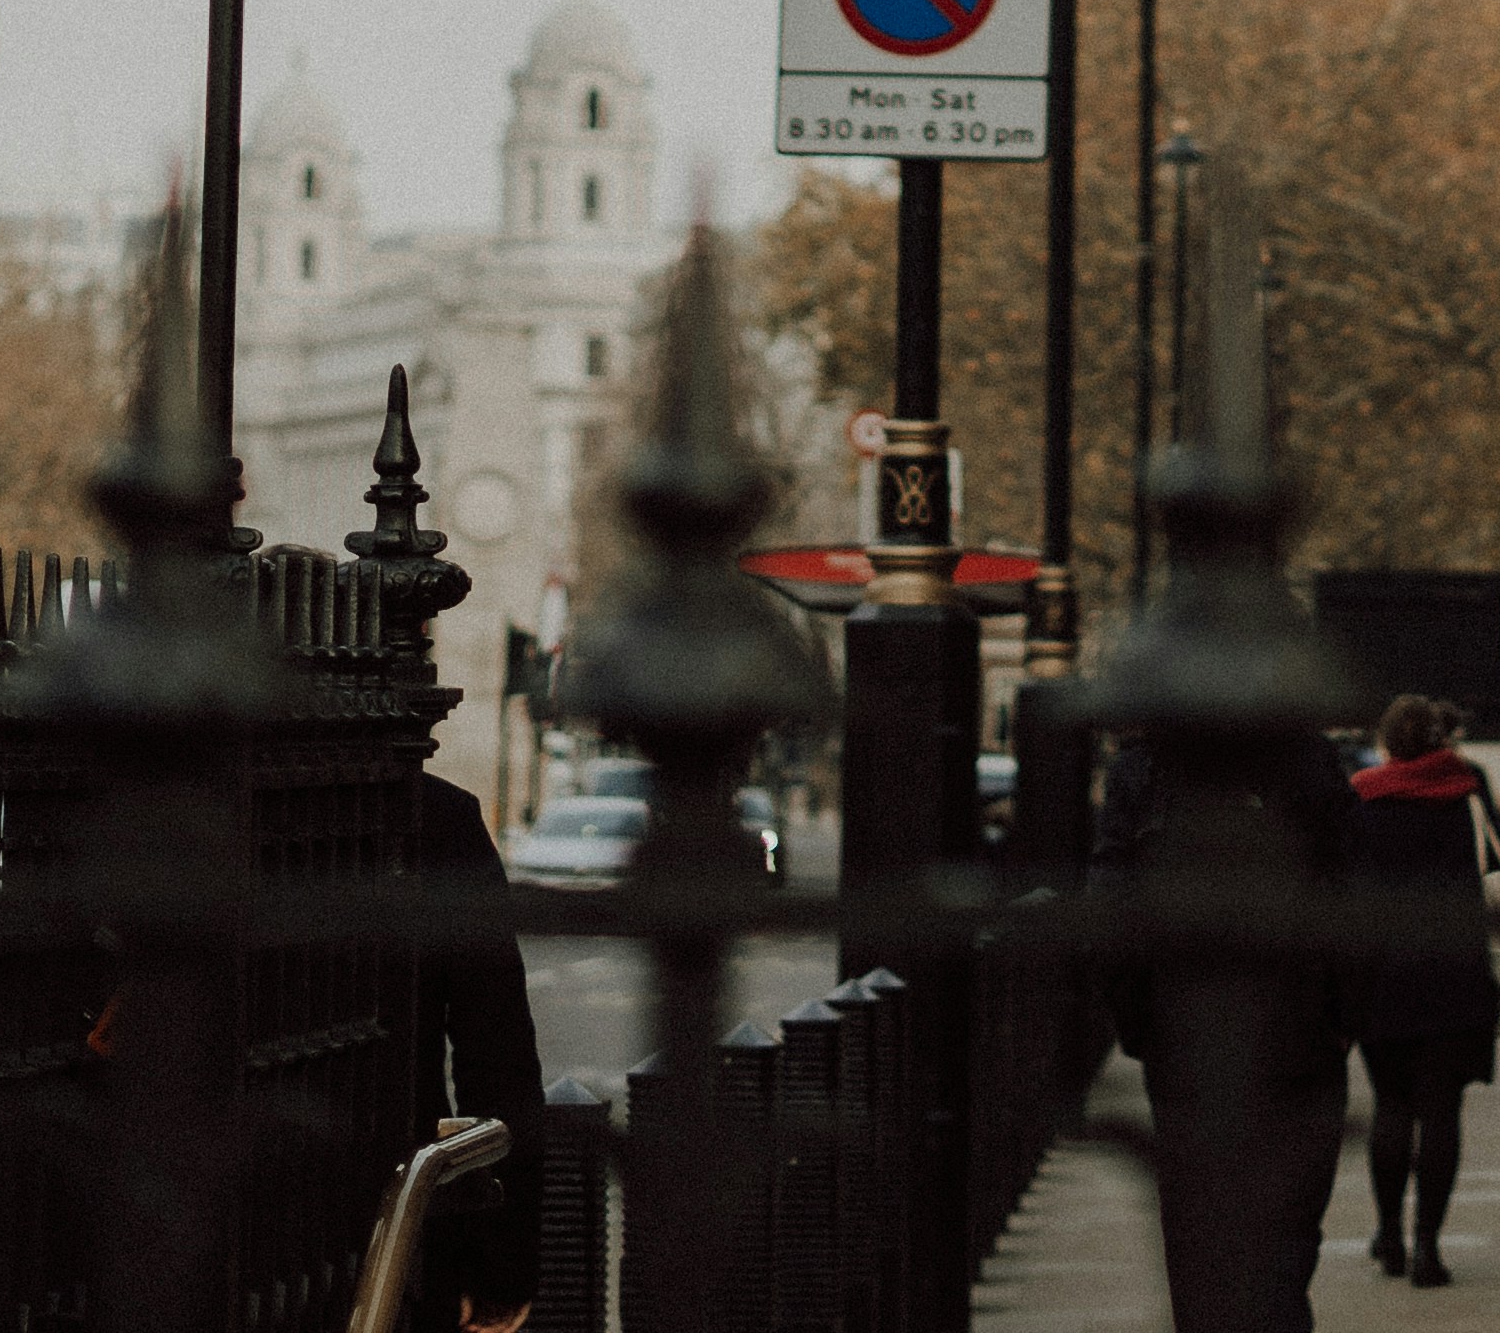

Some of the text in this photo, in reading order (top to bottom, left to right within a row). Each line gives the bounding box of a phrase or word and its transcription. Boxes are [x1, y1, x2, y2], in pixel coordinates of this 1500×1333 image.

[849, 87, 905, 109] Mon
[931, 88, 976, 111] Sat
[860, 125, 898, 141] am
[993, 128, 1035, 147] pm
